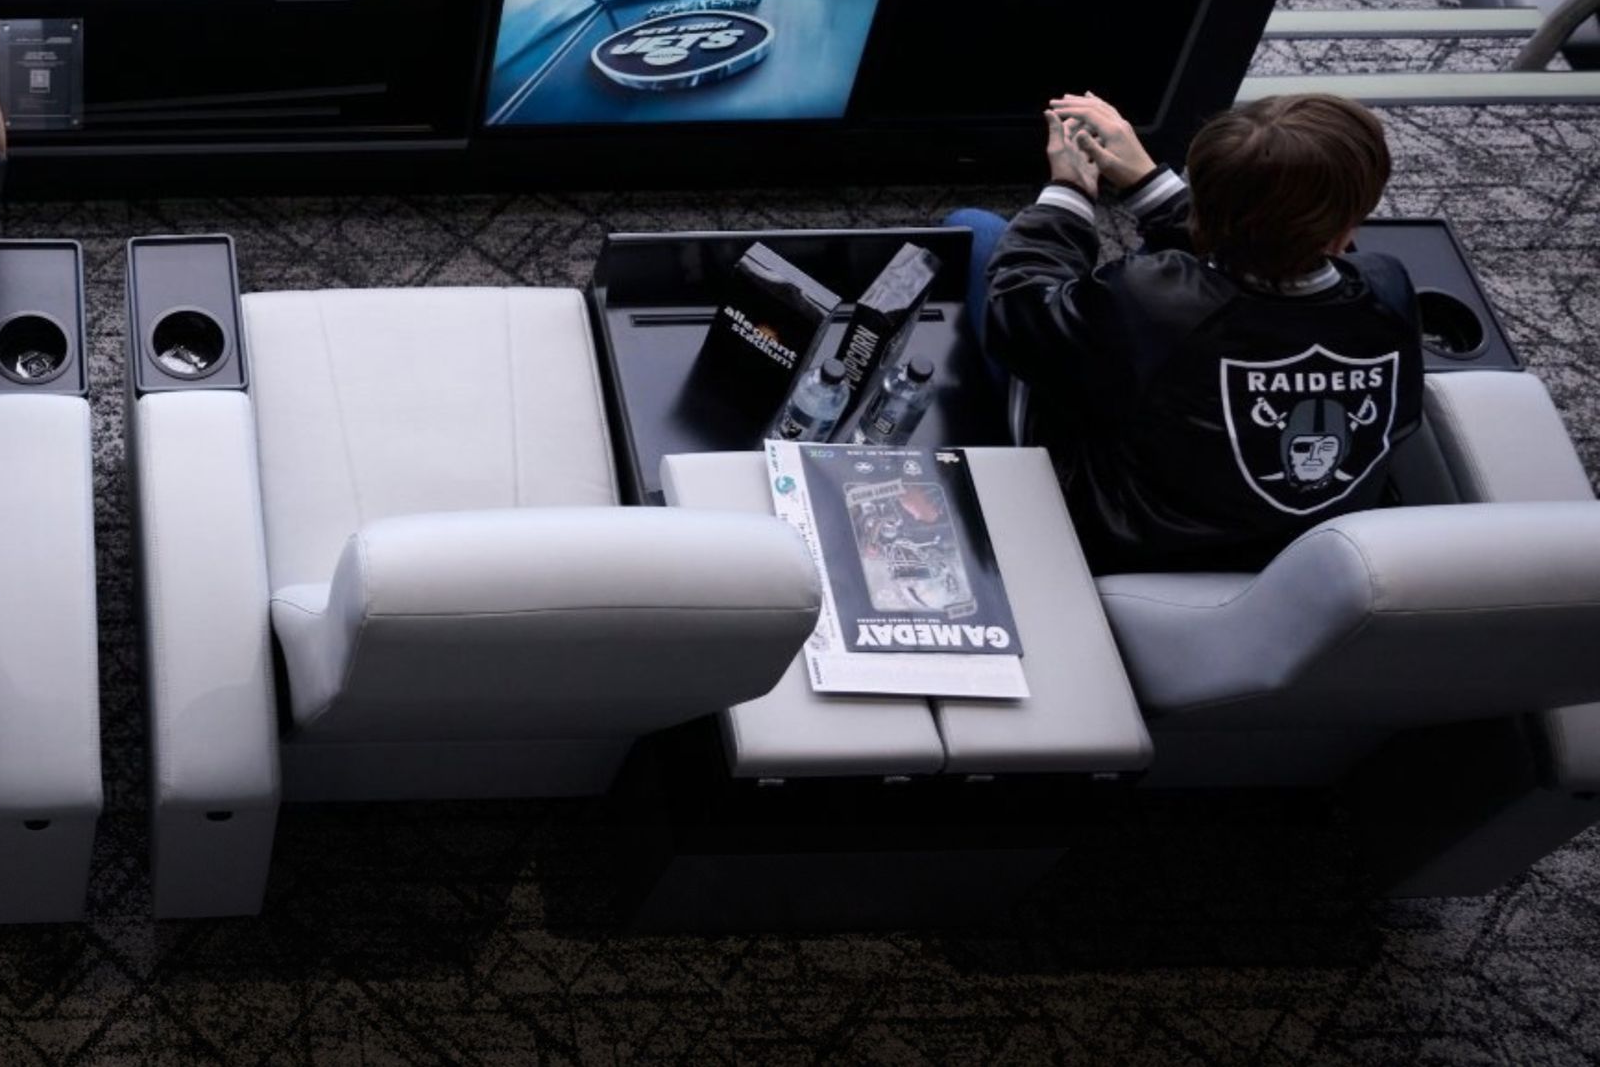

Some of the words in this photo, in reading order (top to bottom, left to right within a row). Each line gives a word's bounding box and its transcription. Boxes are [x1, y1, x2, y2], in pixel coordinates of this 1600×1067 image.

[609, 29, 745, 55] JETS
[723, 305, 798, 362] allegiant
[731, 322, 793, 370] stadium
[1247, 367, 1384, 392] RAIDERS
[856, 624, 1010, 648] GAMEDAY
